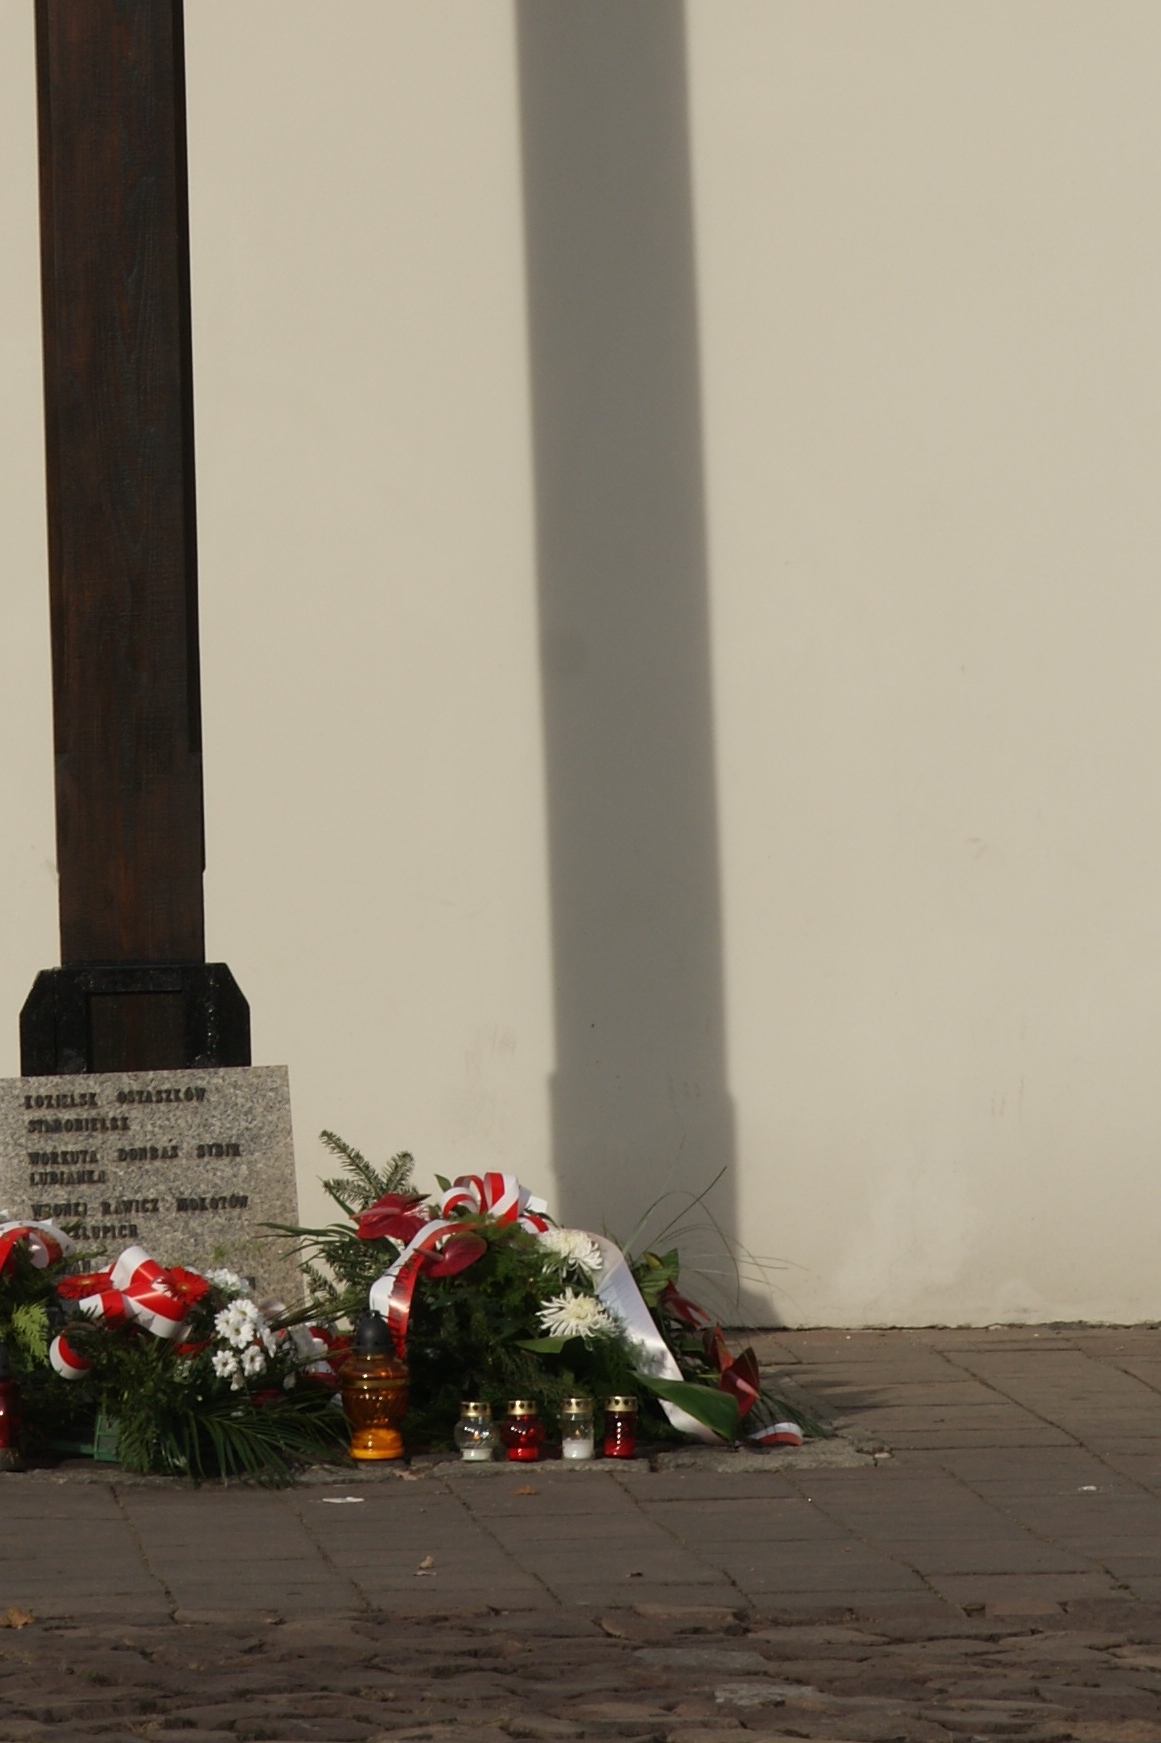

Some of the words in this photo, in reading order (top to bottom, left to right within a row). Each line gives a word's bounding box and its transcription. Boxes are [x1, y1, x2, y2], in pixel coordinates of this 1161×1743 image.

[23, 1092, 99, 1109] KOZIELSK
[116, 1086, 207, 1104] OSTASZKÓW
[27, 1149, 99, 1166] WORKUTA
[29, 1170, 107, 1186] LUBIANKA
[100, 1197, 160, 1215] RAWICZ
[175, 1193, 249, 1212] MOKOTÓW
